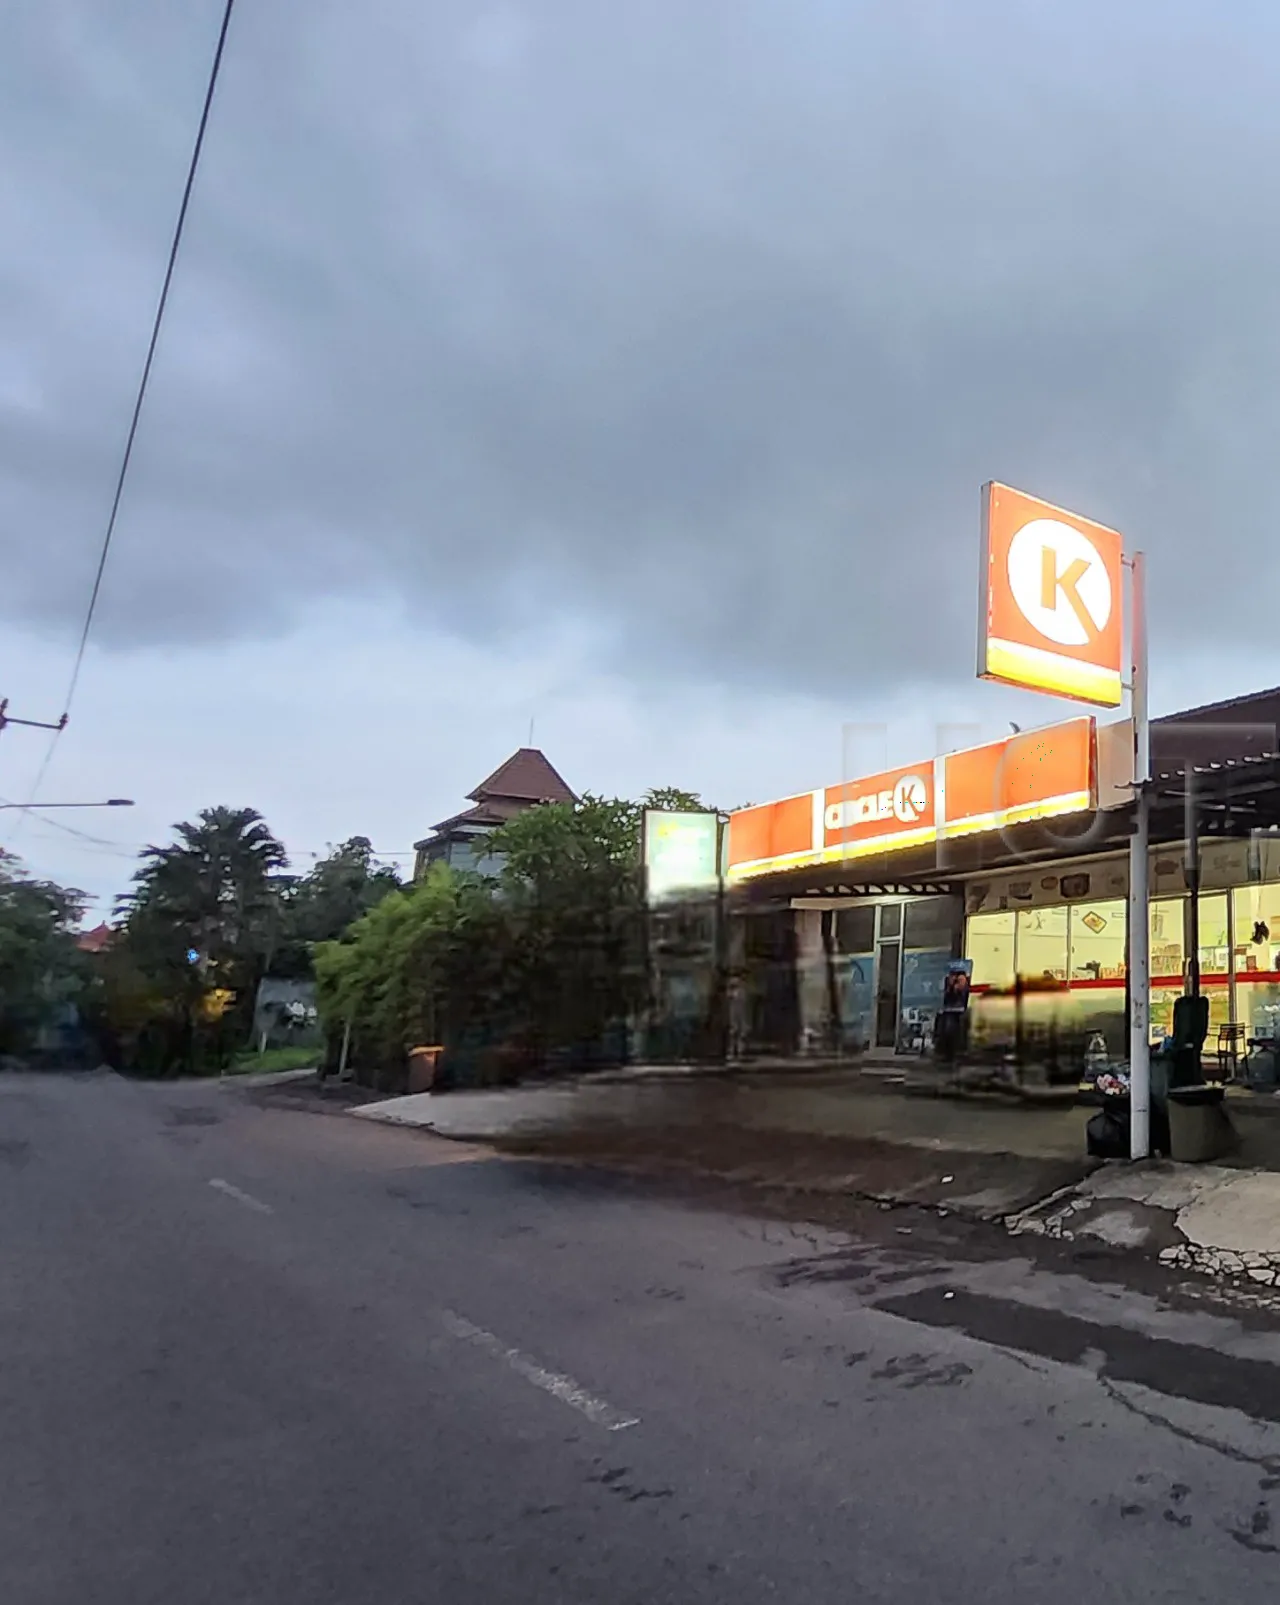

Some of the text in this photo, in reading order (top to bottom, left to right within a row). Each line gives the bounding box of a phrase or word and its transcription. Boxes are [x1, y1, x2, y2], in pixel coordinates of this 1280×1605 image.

[1039, 543, 1098, 644] K
[824, 783, 921, 830] CCLE K
